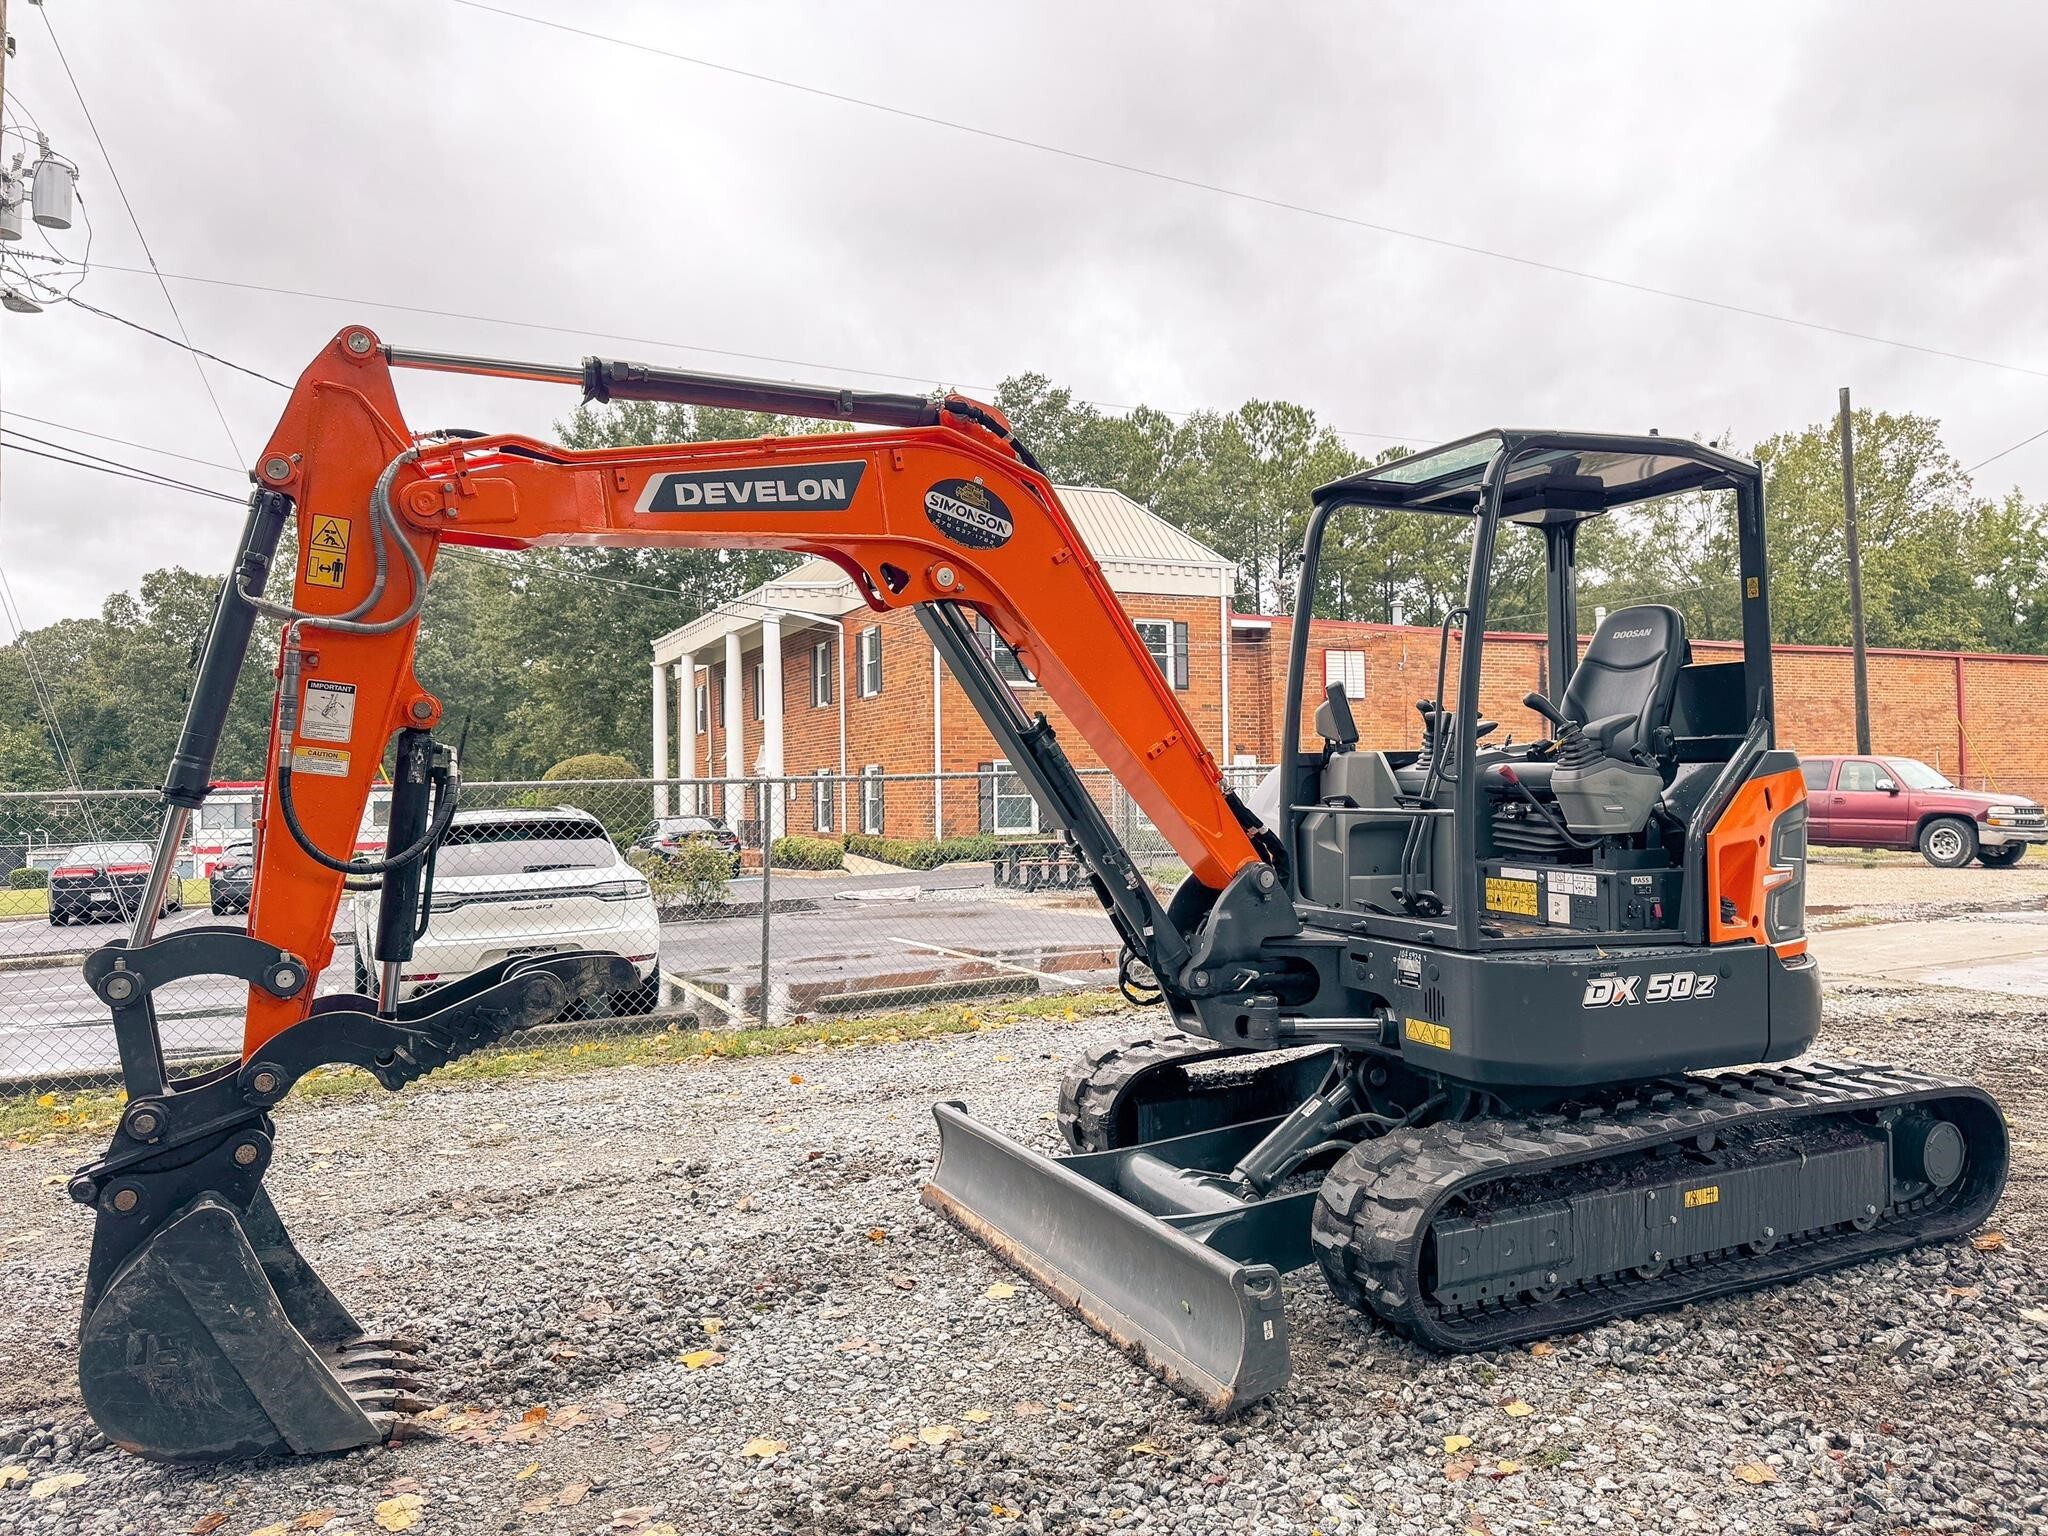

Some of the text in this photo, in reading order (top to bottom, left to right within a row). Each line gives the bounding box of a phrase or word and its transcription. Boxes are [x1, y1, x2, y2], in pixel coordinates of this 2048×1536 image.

[674, 478, 846, 506] DEVELON
[928, 508, 1005, 542] EQUIPMENT
[929, 494, 1006, 535] SIMONSON
[1612, 628, 1653, 639] DOOSAN
[310, 682, 353, 693] IMPORTANT
[307, 750, 339, 759] CAUTION
[1582, 976, 1641, 1009] DX
